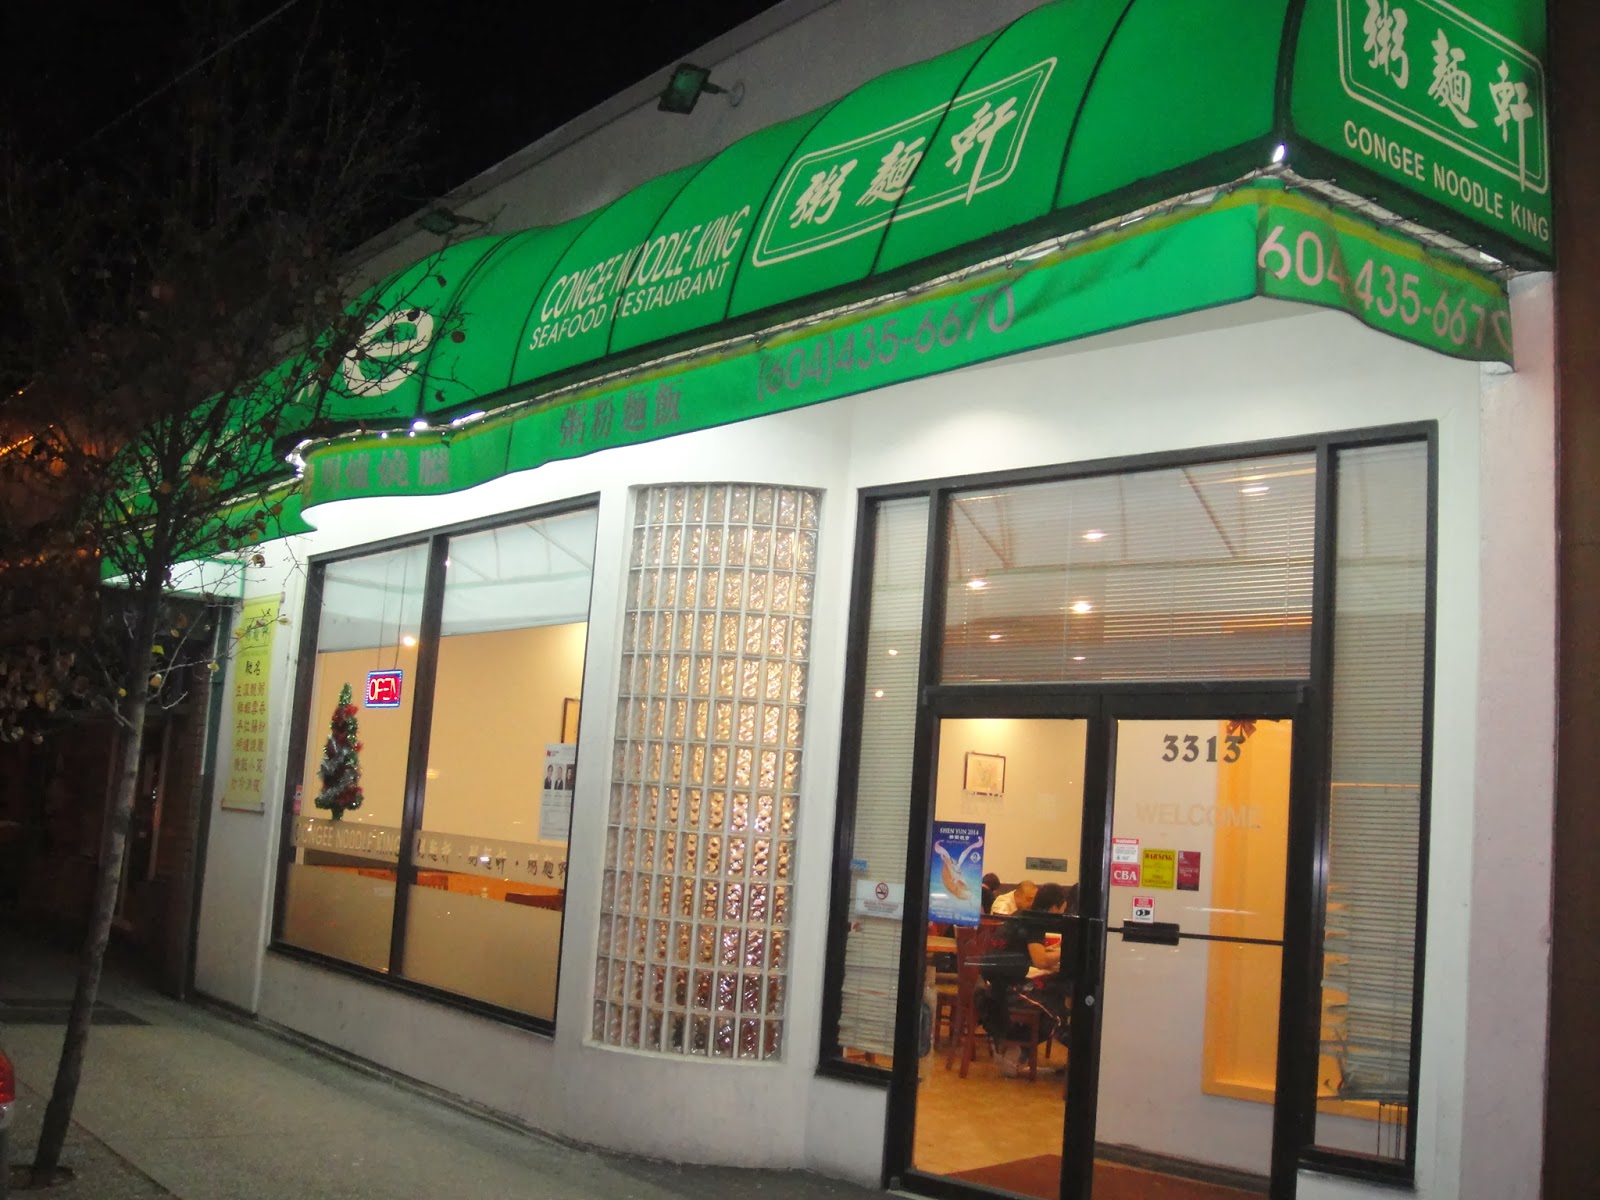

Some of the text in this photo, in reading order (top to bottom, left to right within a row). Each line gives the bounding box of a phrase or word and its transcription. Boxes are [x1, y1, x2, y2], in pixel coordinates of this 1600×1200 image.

[1344, 120, 1550, 242] CONGEE NOODLE KING
[540, 204, 751, 323] CONGEE NOODLE KING
[529, 261, 730, 351] SEAFOOD RESTAURANT
[1161, 734, 1242, 763] 3313
[1136, 802, 1264, 829] WELCOME
[940, 827, 955, 835] SHEN
[1113, 869, 1137, 881] CBA
